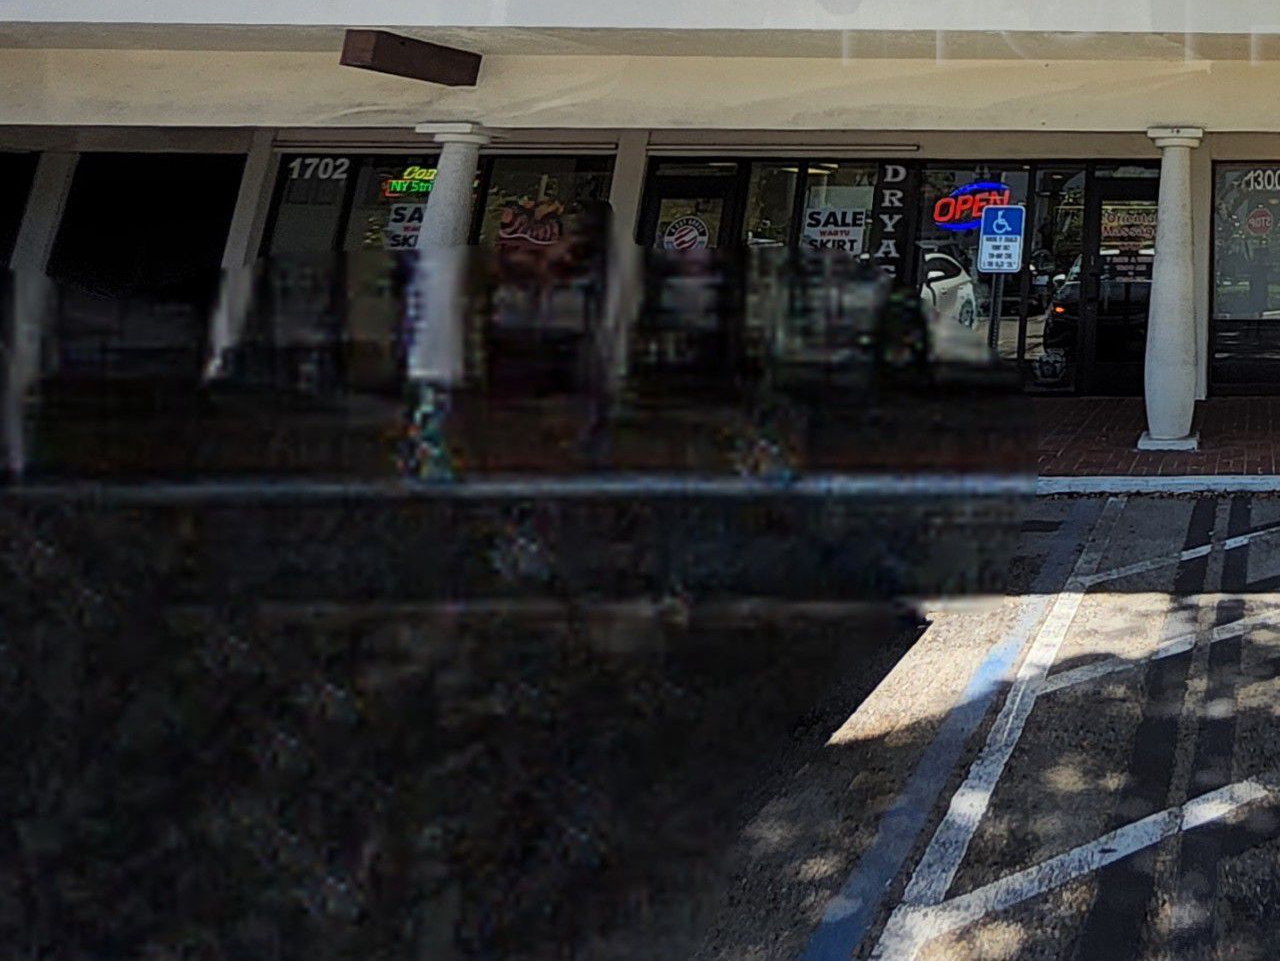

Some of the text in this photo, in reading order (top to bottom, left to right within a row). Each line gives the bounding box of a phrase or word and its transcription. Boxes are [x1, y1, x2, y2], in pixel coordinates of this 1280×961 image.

[289, 158, 349, 179] 1702
[933, 189, 1010, 222] OPEN
[391, 206, 424, 223] SA
[806, 211, 865, 228] SALE
[390, 235, 418, 248] SKI
[808, 239, 858, 252] SKIRT
